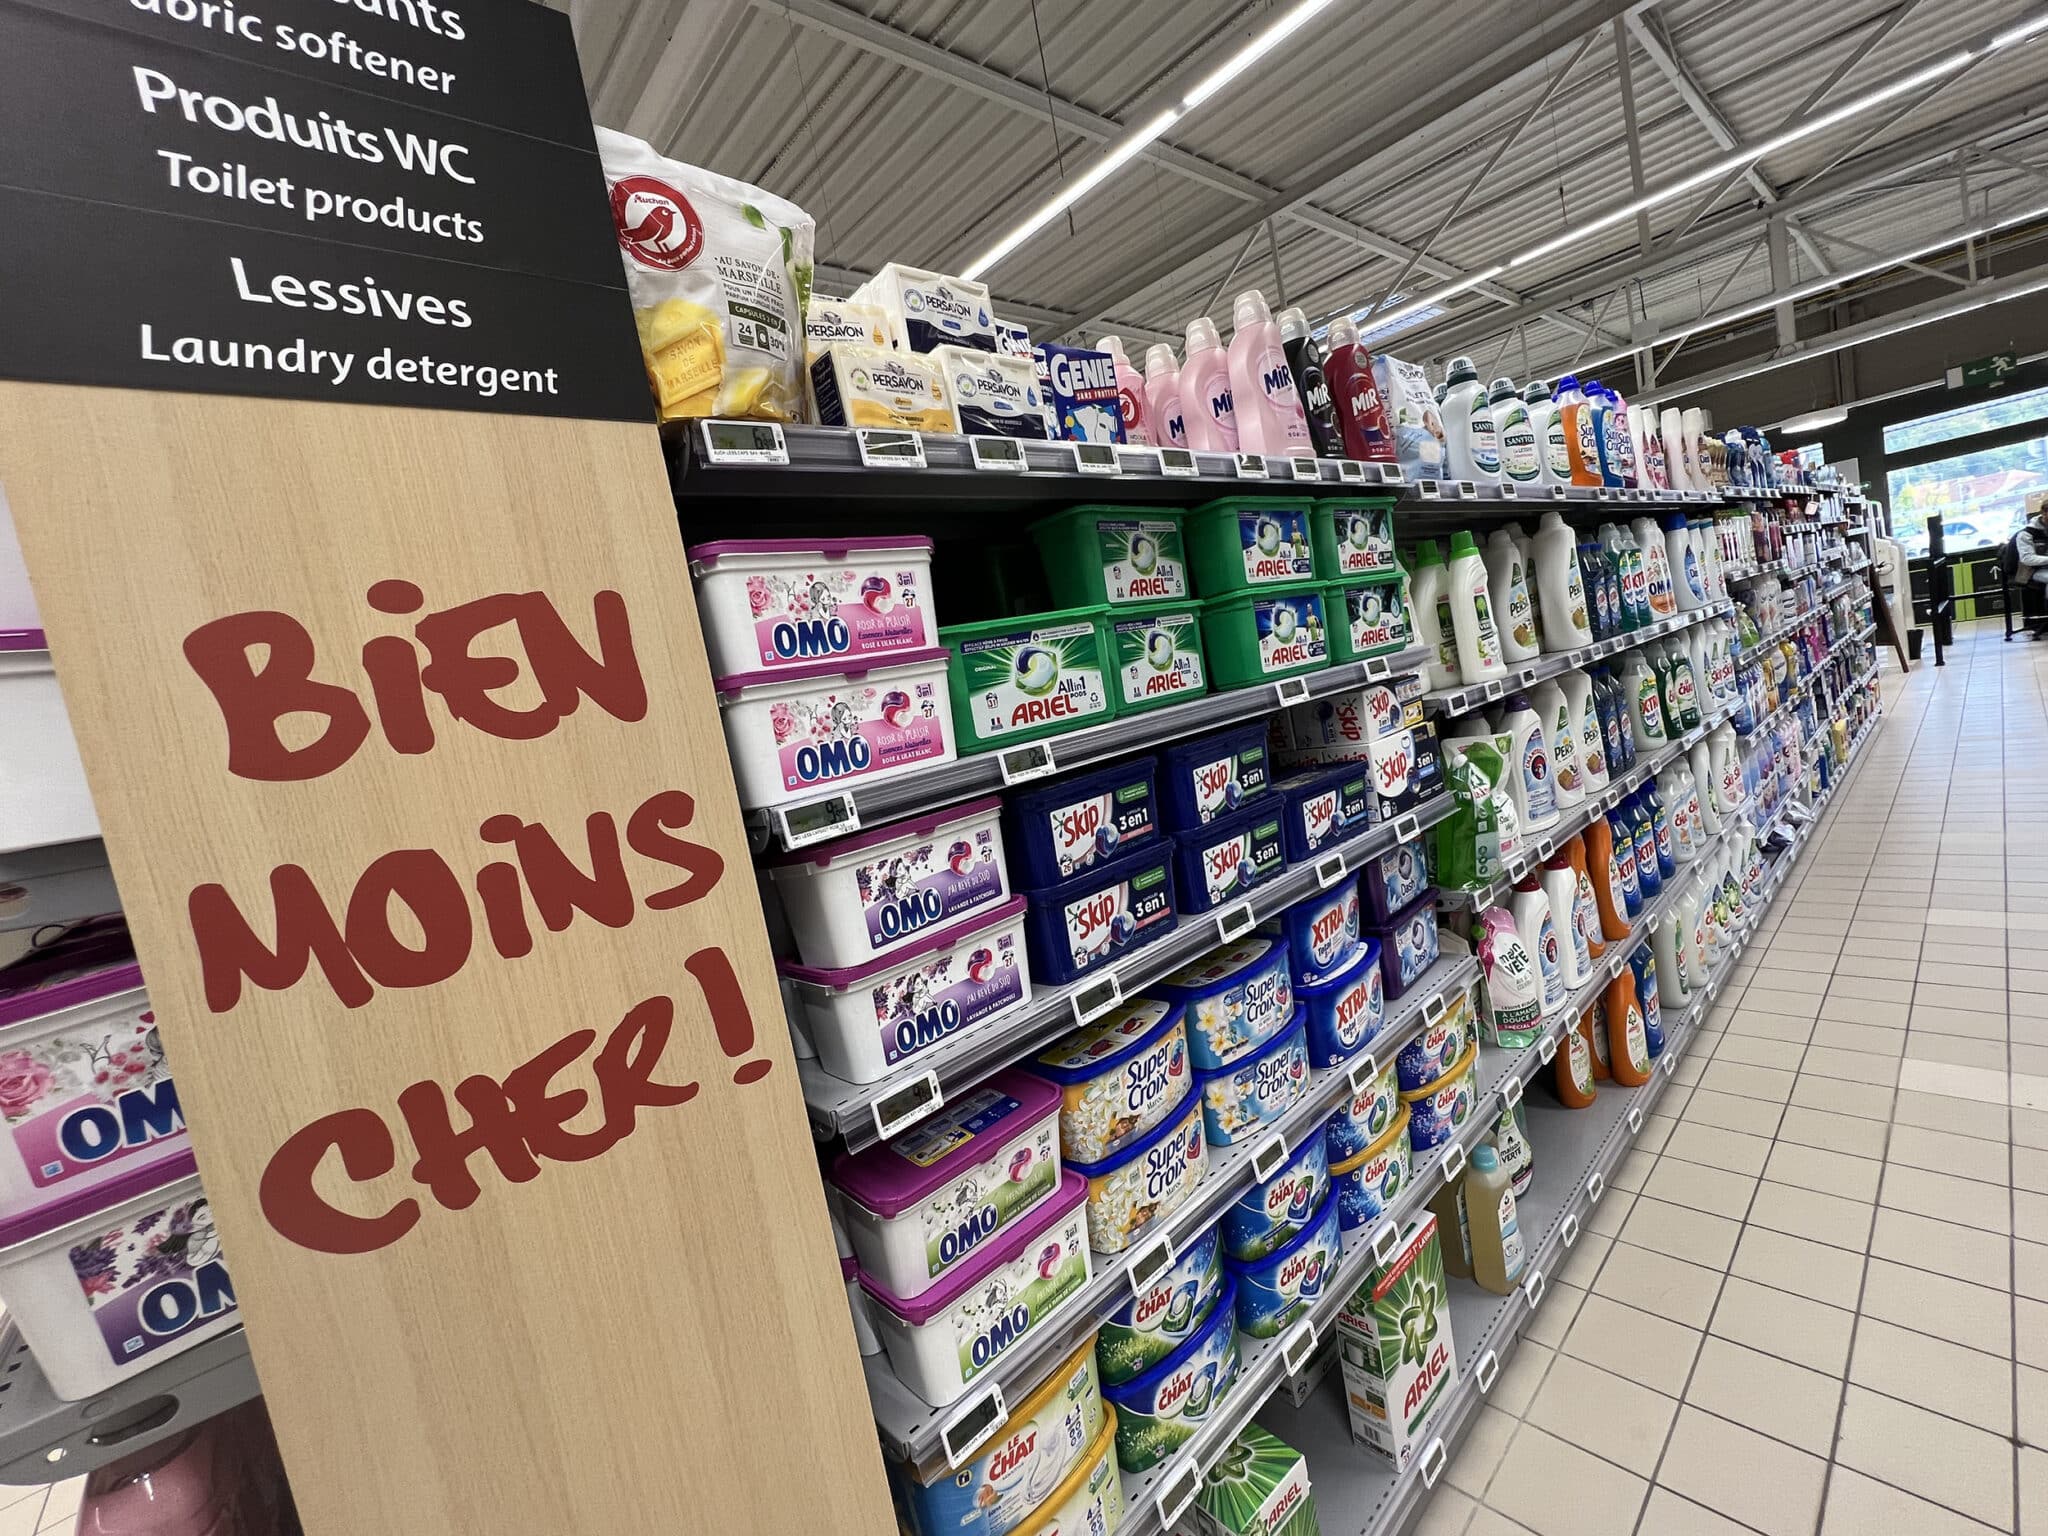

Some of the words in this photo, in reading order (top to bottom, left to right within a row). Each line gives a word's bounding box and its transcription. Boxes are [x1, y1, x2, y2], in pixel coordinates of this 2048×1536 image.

[275, 24, 455, 94] softener
[132, 66, 385, 164] Produits
[383, 127, 476, 185] WC
[157, 149, 295, 209] Toilet
[305, 185, 485, 243] products
[229, 256, 473, 329] Lessives
[925, 295, 971, 317] PERSAVON
[739, 323, 752, 335] 24
[807, 324, 864, 338] PERSAVON
[140, 323, 355, 385] Laundry
[366, 347, 559, 396] detergent
[1050, 354, 1116, 397] GENIE
[872, 373, 924, 391] PERSAVON
[977, 378, 1021, 397] PERSAVON
[1256, 559, 1292, 577] ARIEL
[1348, 552, 1378, 568] ARIEL
[1129, 578, 1169, 597] ARIEL
[1649, 580, 1666, 595] OM
[773, 618, 849, 659] OMO
[1271, 644, 1307, 666] ARIEL
[1360, 628, 1390, 647] ARIEL
[1070, 691, 1087, 699] PODS
[1146, 671, 1187, 696] ARIEL
[1011, 694, 1079, 727] ARIEL
[796, 736, 870, 781] OMO
[1382, 750, 1407, 789] Skip
[1202, 763, 1228, 799] Skip
[1064, 802, 1099, 848] Skip
[1312, 796, 1333, 828] Skip
[1213, 842, 1241, 879] Skip
[881, 890, 941, 936] OMO
[1077, 894, 1115, 940] Skip
[1245, 973, 1277, 1006] Super
[1246, 991, 1276, 1023] Croix
[897, 1001, 960, 1052] OMO
[1426, 1028, 1446, 1050] CHAT
[1126, 1041, 1170, 1089] Super
[1257, 1048, 1291, 1084] Super
[1128, 1070, 1169, 1111] Croix
[1258, 1066, 1290, 1100] Croix
[1437, 1087, 1457, 1109] CHAT
[61, 1080, 186, 1162] OM
[1352, 1093, 1376, 1117] CHAT
[1147, 1125, 1188, 1178] Super
[1501, 1149, 1521, 1165] VERTE
[1147, 1152, 1188, 1199] Croix
[1365, 1160, 1389, 1184] CHAT
[1268, 1178, 1295, 1210] CHAT
[939, 1205, 997, 1263] OMO
[1280, 1255, 1307, 1287] CHAT
[145, 1262, 237, 1334] OM
[1136, 1285, 1173, 1325] CHAT
[1150, 1286, 1159, 1299] LE
[972, 1305, 1028, 1368] OMO
[1337, 1313, 1373, 1334] ARIEL
[1158, 1371, 1193, 1411] CHAT
[1172, 1373, 1181, 1386] LE
[1404, 1342, 1449, 1419] ARIEL
[989, 1431, 1037, 1481] CHAT
[1008, 1434, 1019, 1450] LE
[1267, 1482, 1302, 1532] ARIEL
